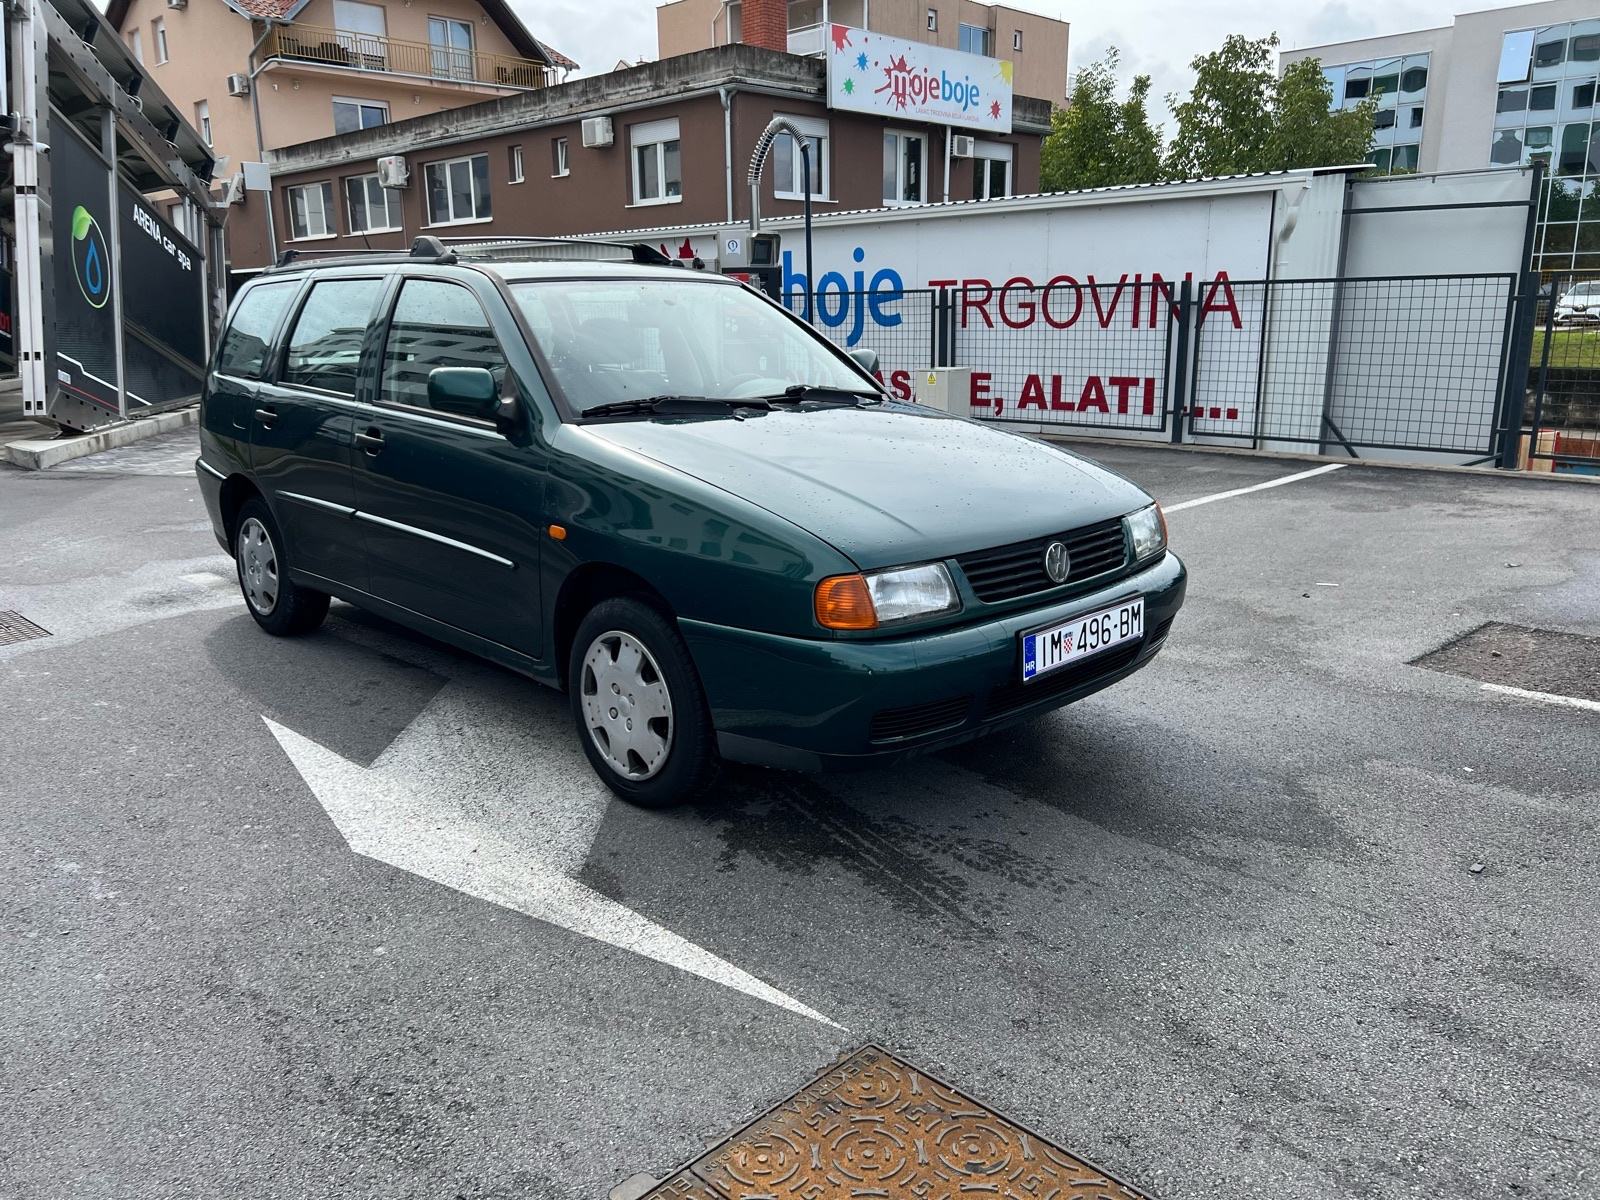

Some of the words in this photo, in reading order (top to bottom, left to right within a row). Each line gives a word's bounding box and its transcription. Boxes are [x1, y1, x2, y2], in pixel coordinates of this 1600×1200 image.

[133, 203, 162, 245] ARENA
[163, 236, 176, 256] car
[177, 249, 192, 271] spa
[783, 247, 904, 348] boje
[928, 271, 1243, 329] TRGOVINA
[1017, 374, 1156, 415] ALATI
[1025, 660, 1036, 672] HR
[1042, 631, 1062, 667] IM
[1077, 603, 1141, 652] 496-BM
